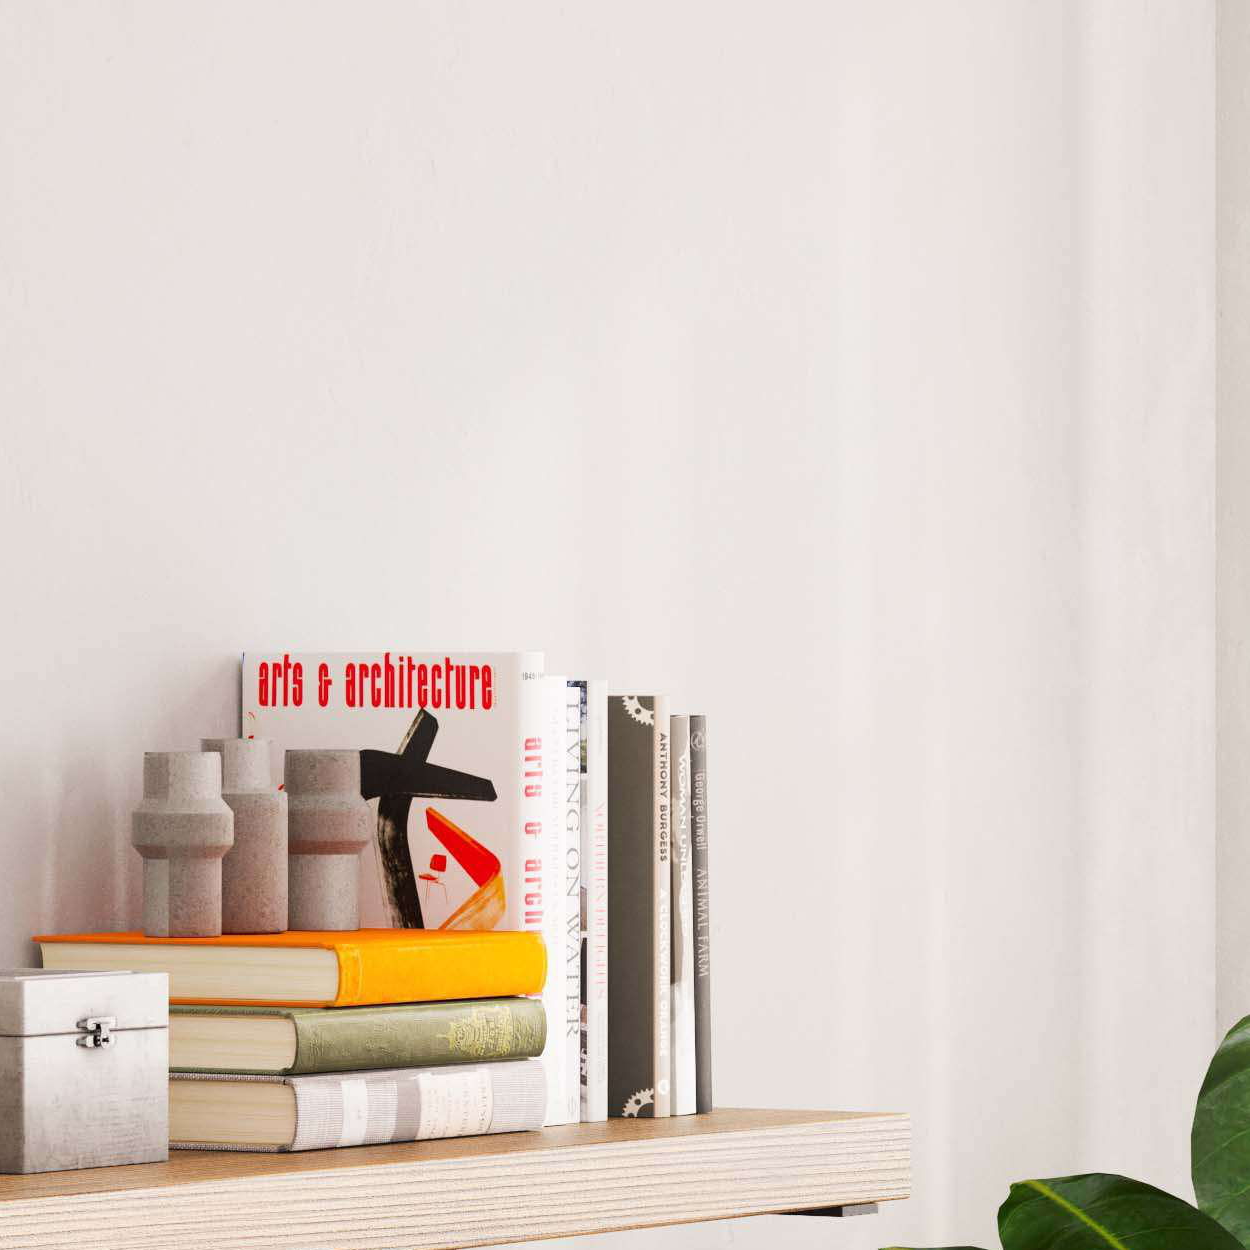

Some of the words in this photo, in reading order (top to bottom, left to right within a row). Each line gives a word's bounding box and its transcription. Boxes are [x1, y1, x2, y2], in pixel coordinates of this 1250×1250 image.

[258, 654, 303, 707] arts
[318, 663, 333, 707] &
[345, 652, 493, 710] architecture
[566, 703, 580, 832] LIVING
[659, 732, 668, 800] ANTHONY
[679, 752, 688, 830] WOMAN
[692, 773, 706, 811] George
[659, 805, 668, 862] BURGESS
[695, 815, 708, 850] Orwell
[566, 847, 580, 897] ON
[696, 868, 709, 930] ANIMAL
[566, 913, 580, 1038] WATER
[697, 936, 710, 977] FARM
